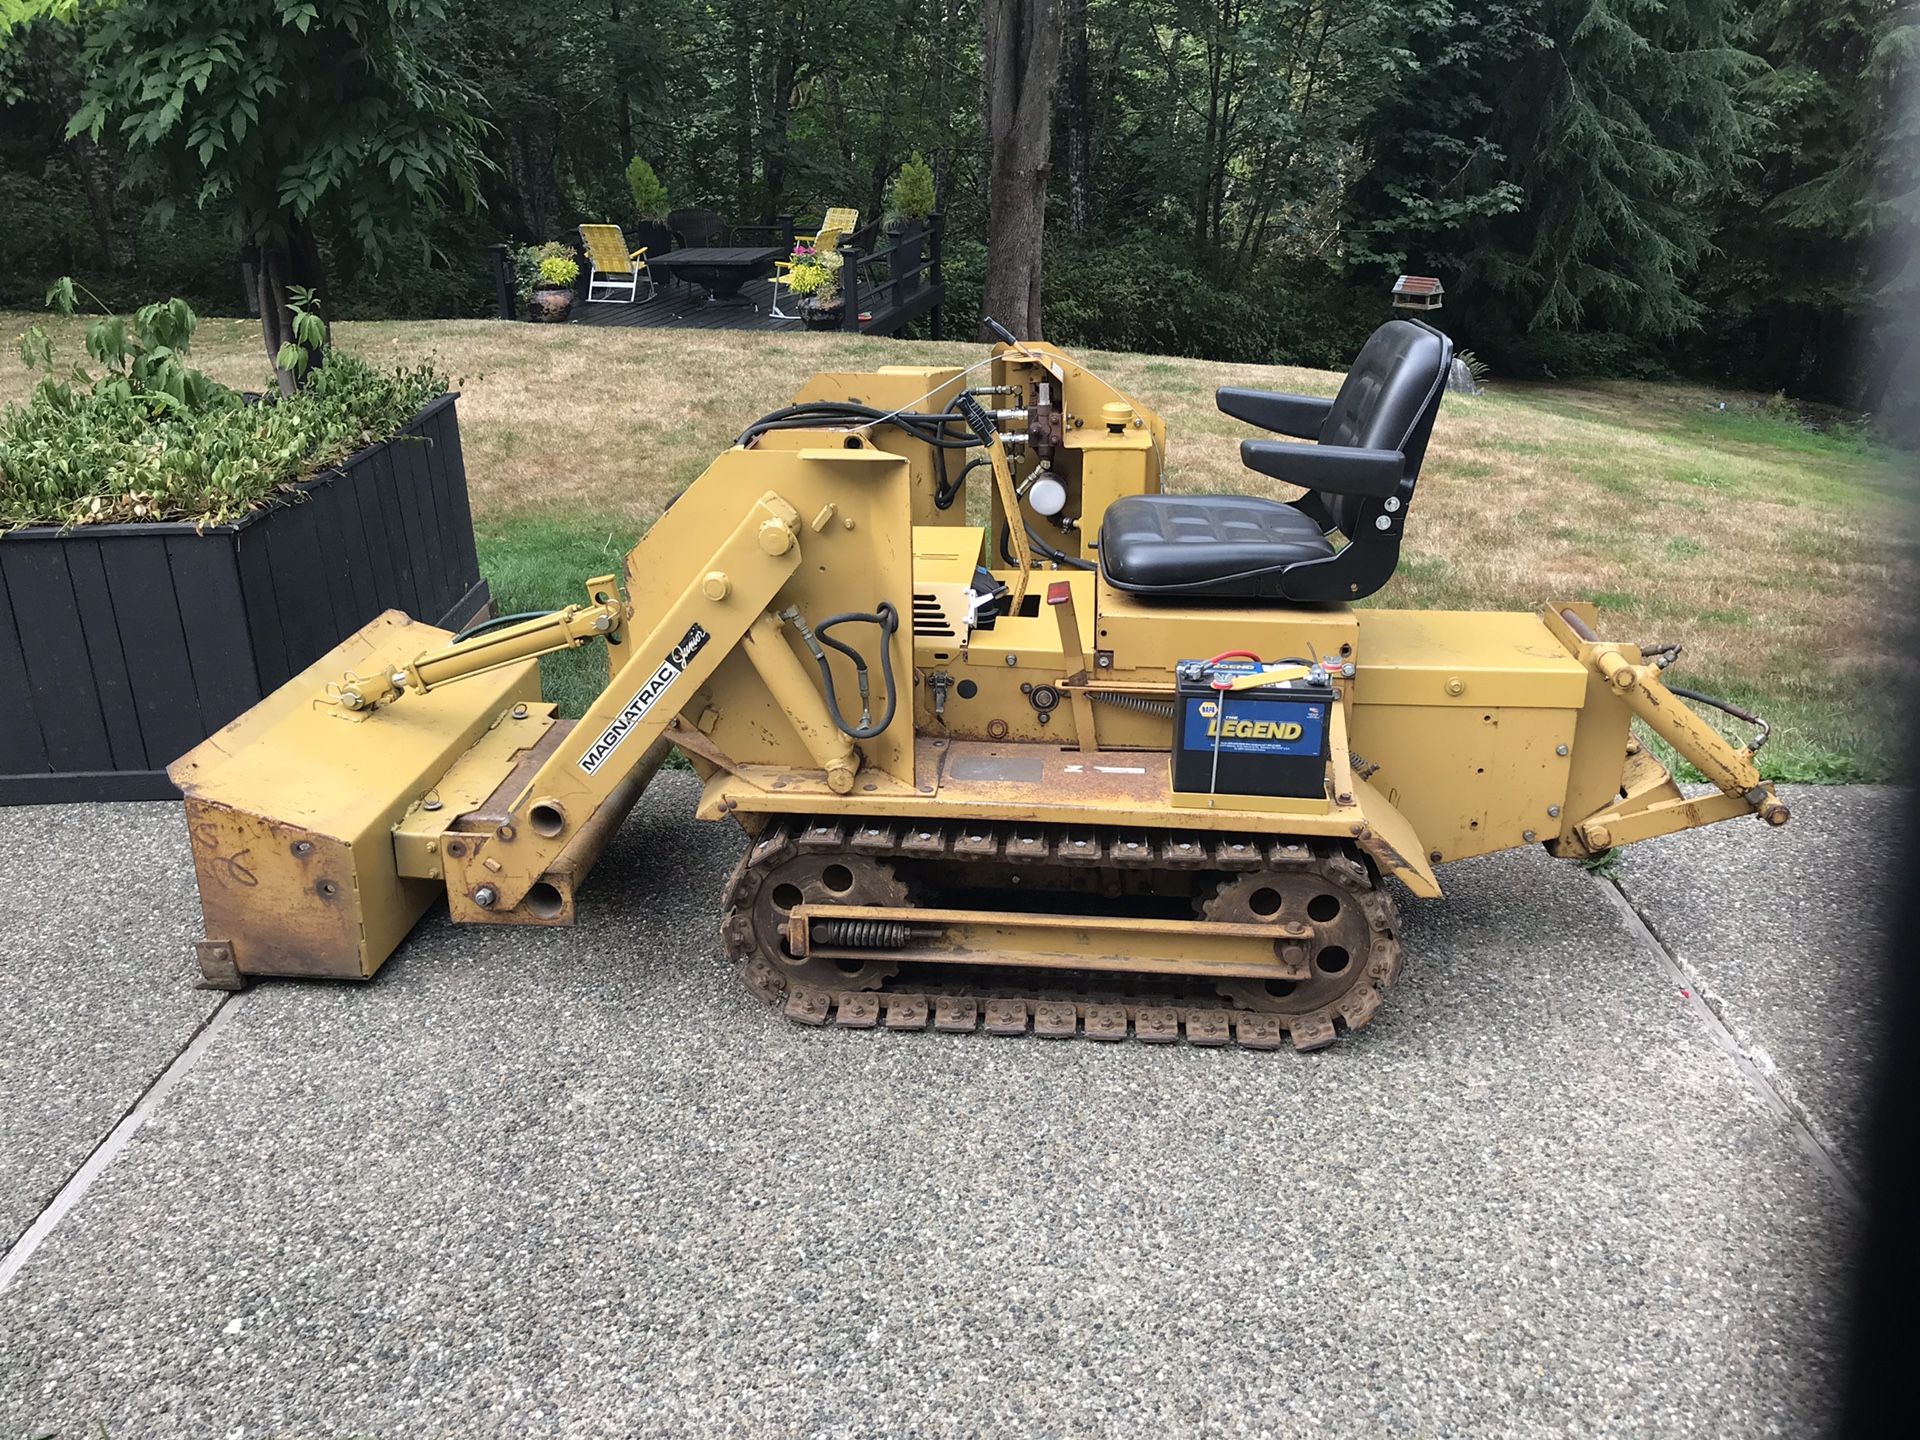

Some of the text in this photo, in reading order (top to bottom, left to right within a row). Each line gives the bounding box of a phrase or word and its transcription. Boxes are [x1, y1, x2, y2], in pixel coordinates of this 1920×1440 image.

[671, 629, 706, 669] Junior
[581, 667, 674, 771] MAGNATRAC
[1207, 719, 1302, 740] LEGEND
